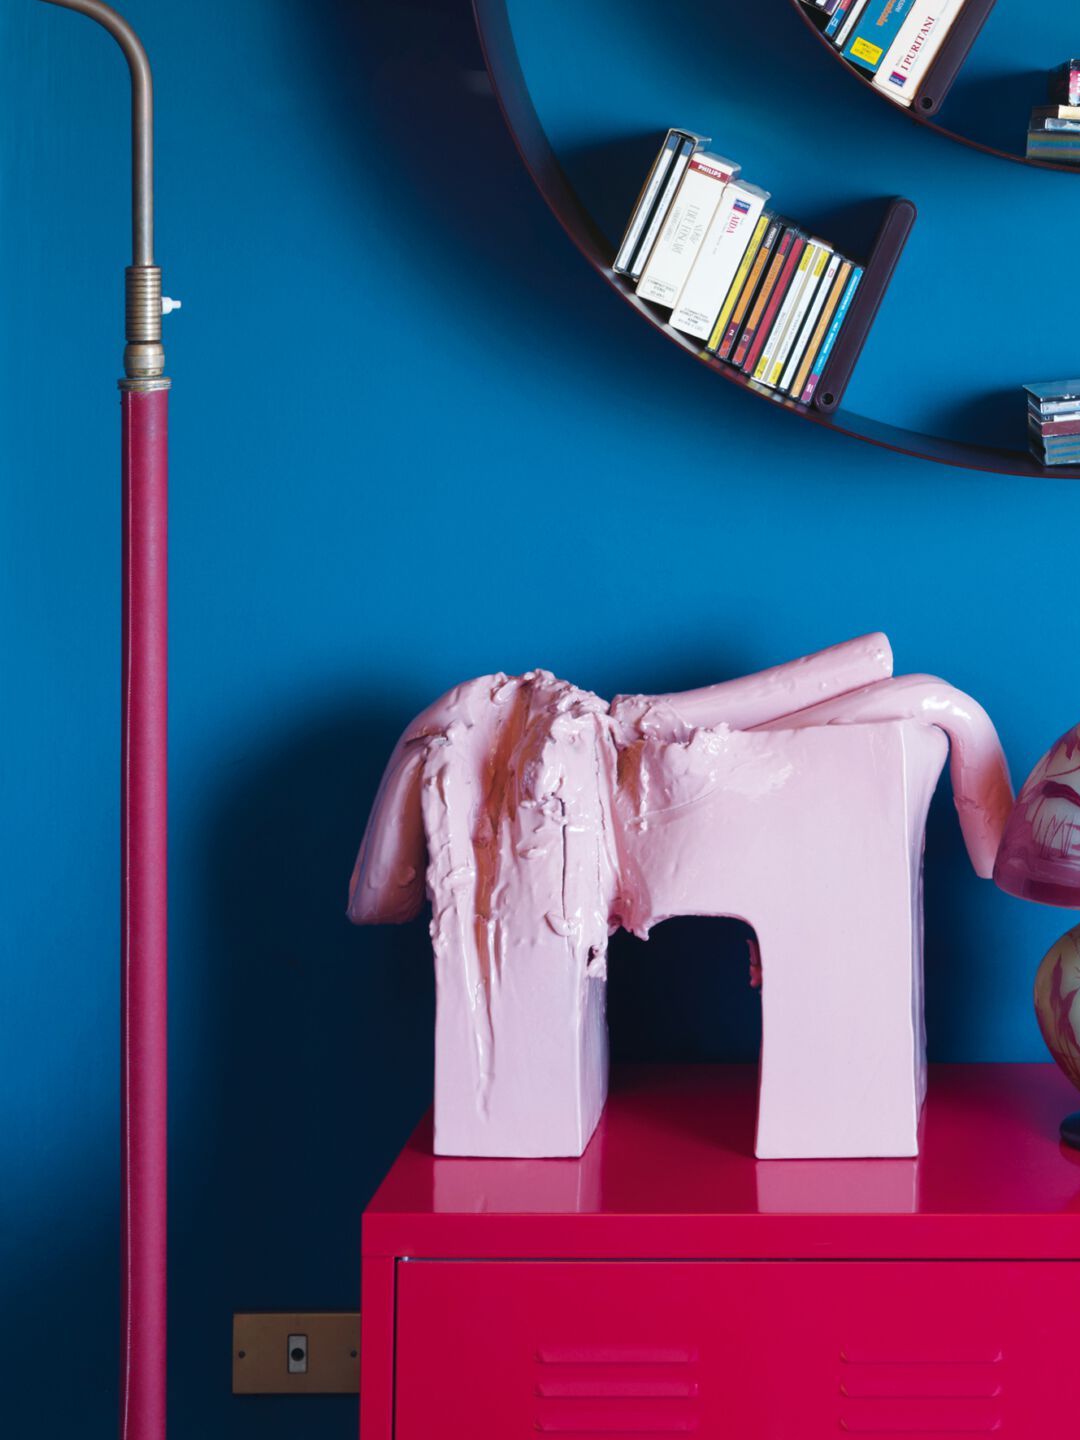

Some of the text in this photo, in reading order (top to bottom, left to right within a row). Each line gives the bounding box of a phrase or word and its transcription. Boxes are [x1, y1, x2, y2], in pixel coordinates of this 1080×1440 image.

[901, 15, 936, 65] PURITANI
[697, 164, 722, 177] PHILIPS
[725, 213, 740, 235] AIDA
